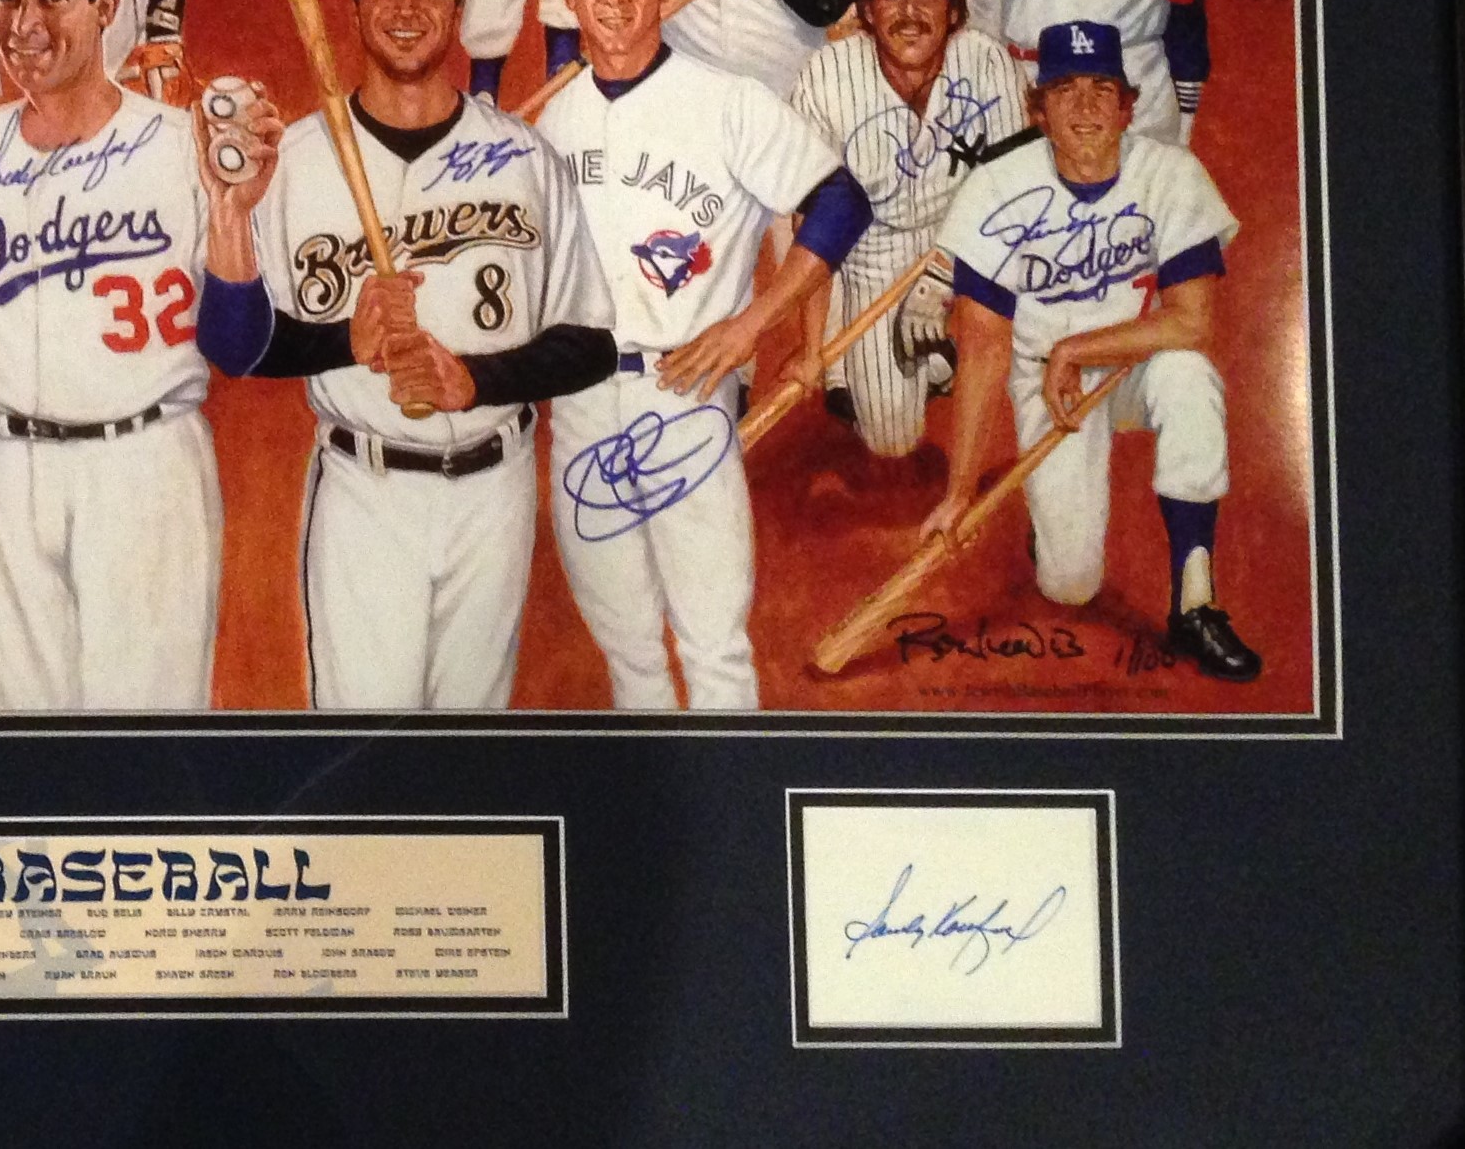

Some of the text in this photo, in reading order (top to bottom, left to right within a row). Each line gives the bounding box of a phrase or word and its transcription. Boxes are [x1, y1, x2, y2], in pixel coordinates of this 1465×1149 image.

[1070, 24, 1095, 55] LA
[622, 151, 725, 227] JAYS
[92, 267, 198, 352] 32
[473, 263, 513, 332] 8
